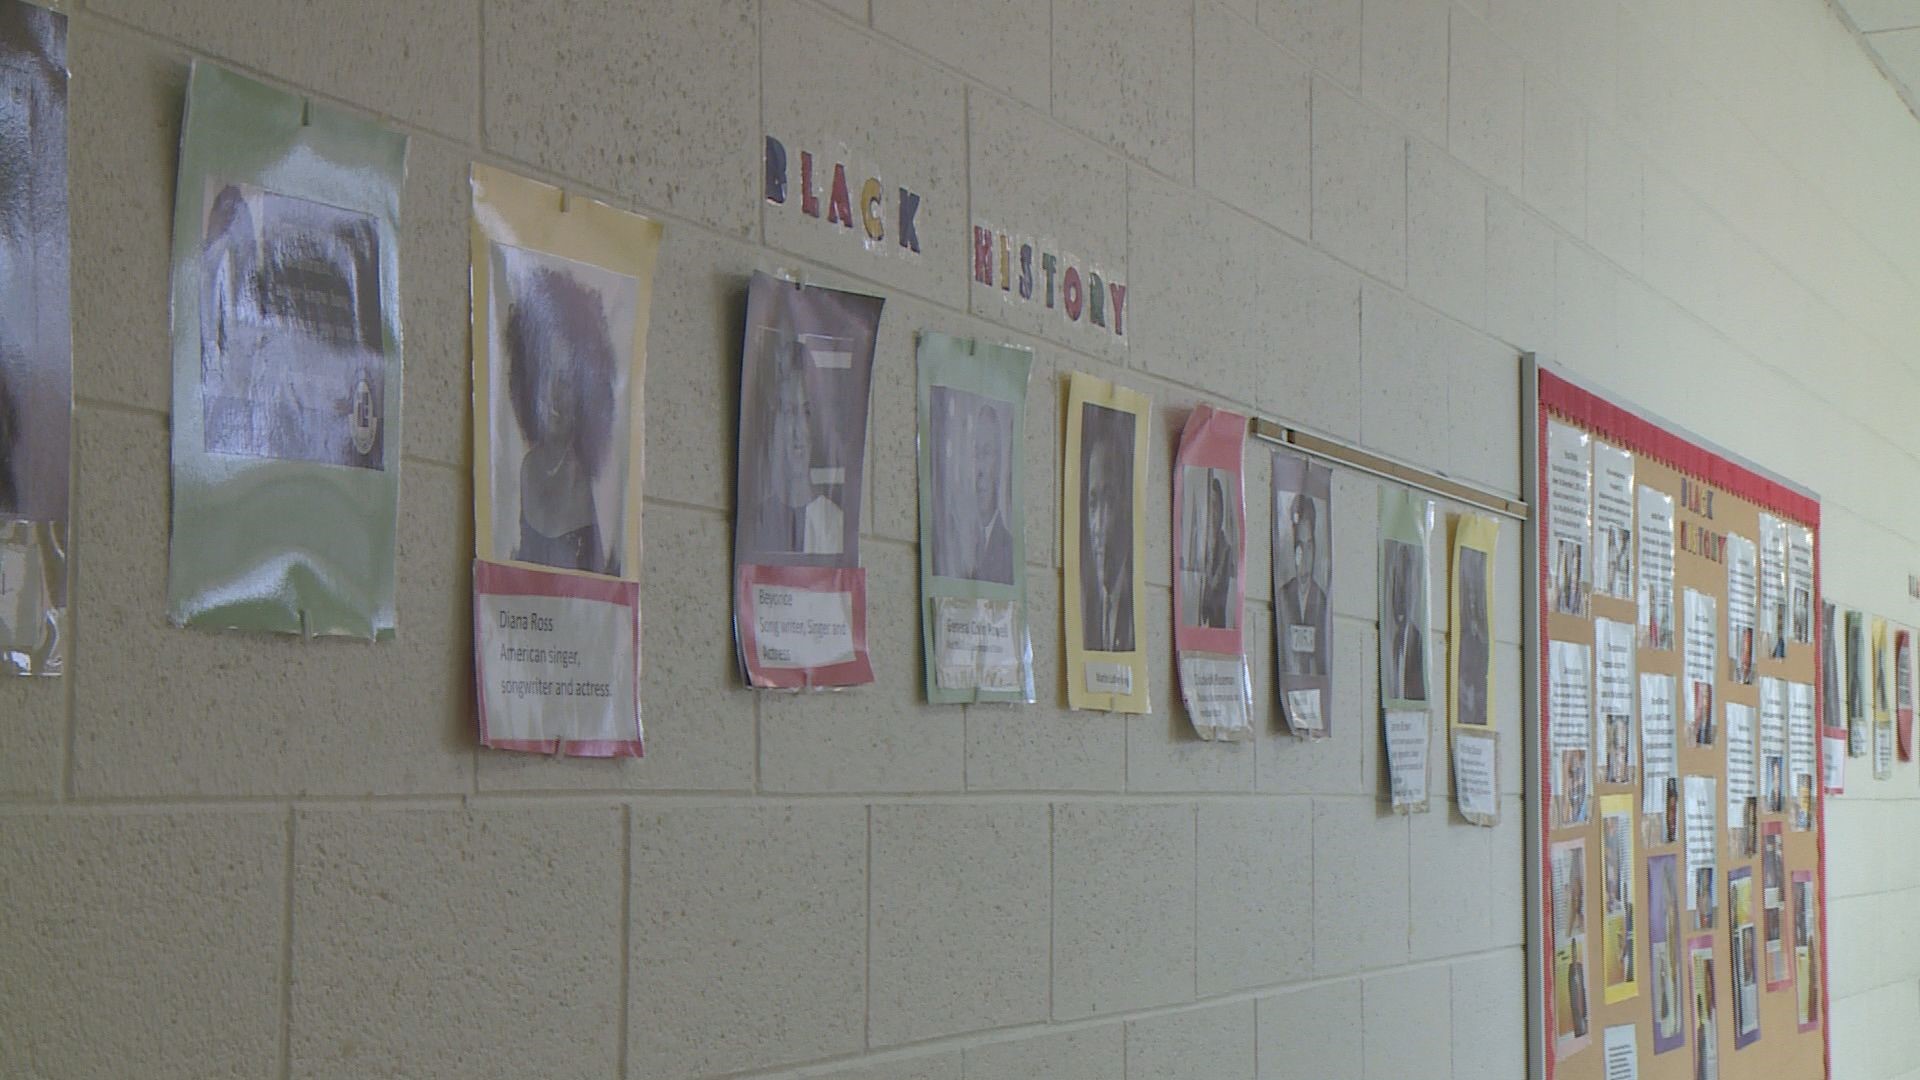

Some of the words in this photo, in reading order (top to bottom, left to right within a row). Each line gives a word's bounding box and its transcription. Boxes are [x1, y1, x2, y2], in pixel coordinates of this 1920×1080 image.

[765, 135, 920, 254] BLACK
[974, 225, 1126, 335] HISTORY
[500, 610, 528, 629] Diana
[531, 612, 553, 631] Ross
[500, 644, 547, 663] American
[549, 645, 581, 668] singer,
[501, 677, 552, 698] songwriter
[555, 678, 574, 697] and
[576, 680, 613, 697] actress.
